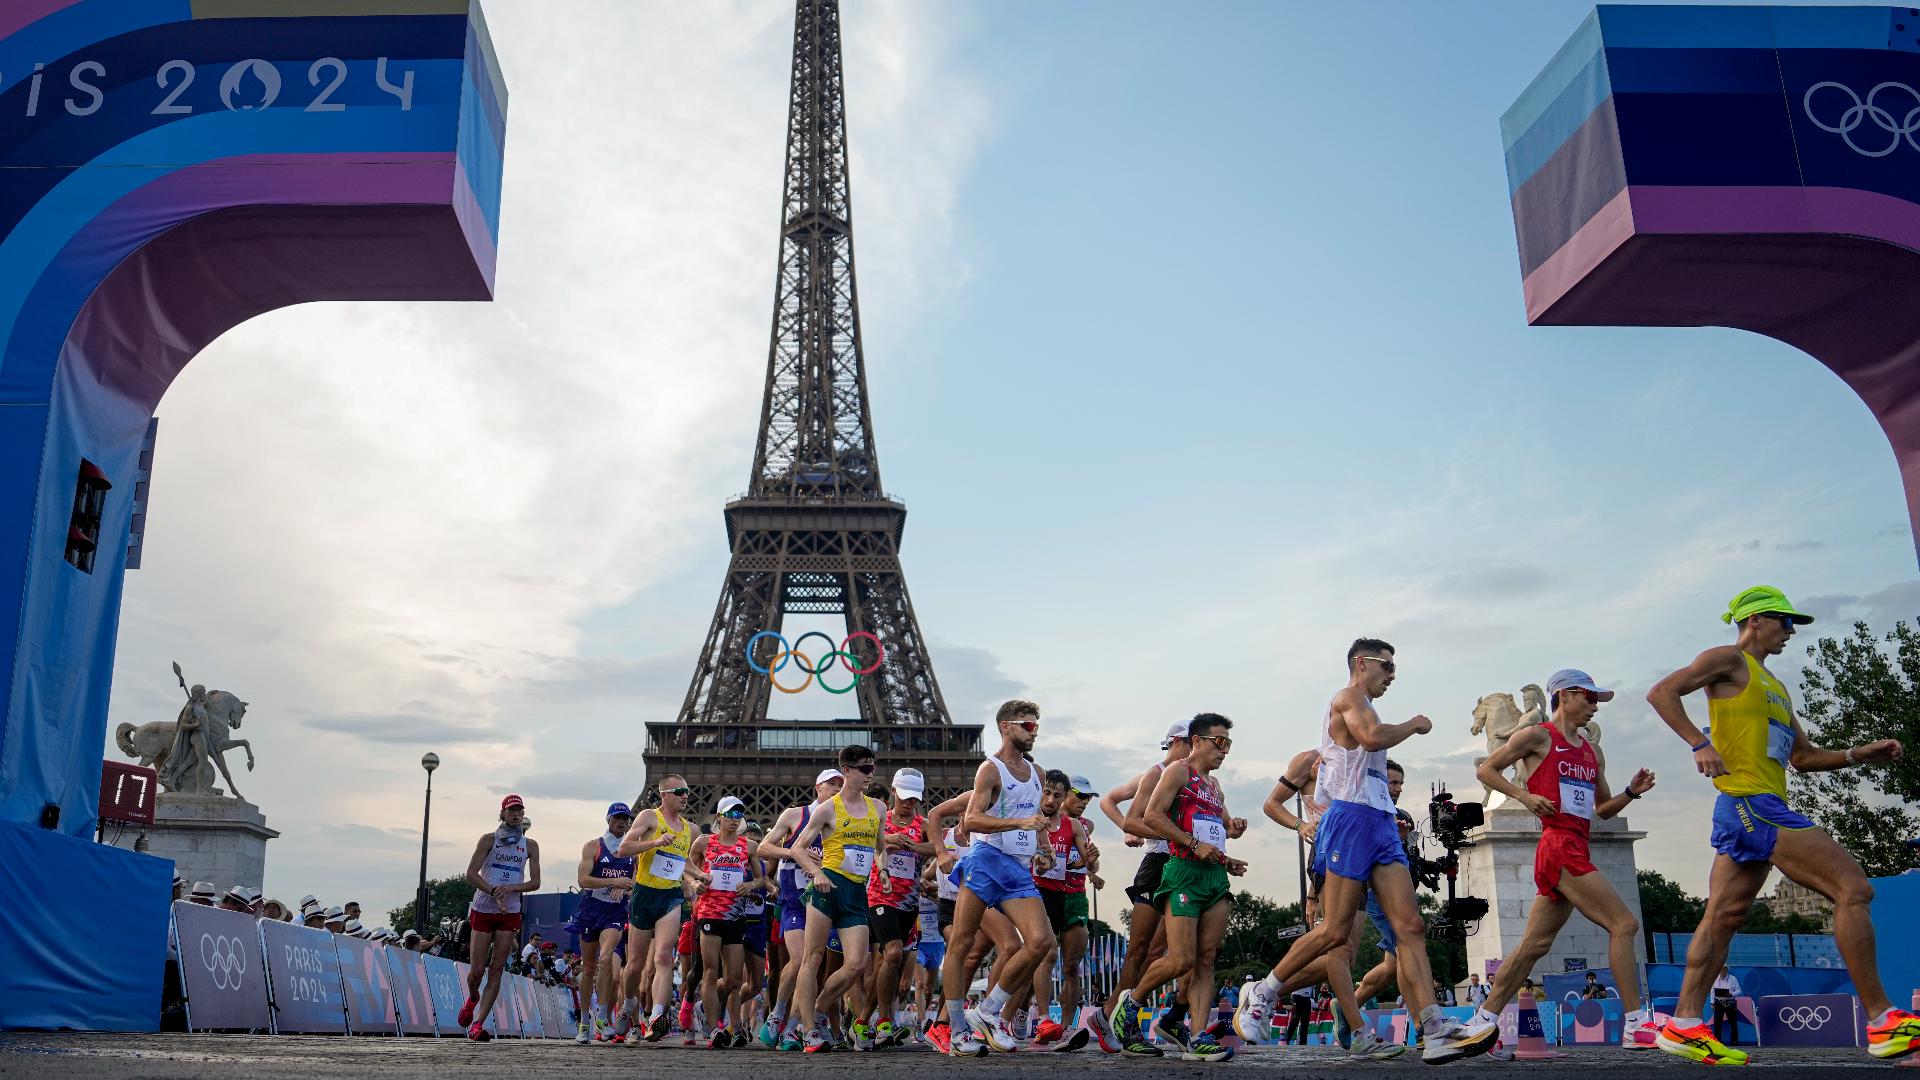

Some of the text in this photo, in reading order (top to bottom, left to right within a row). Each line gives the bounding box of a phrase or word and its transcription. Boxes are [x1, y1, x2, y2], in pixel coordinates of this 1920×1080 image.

[0, 56, 415, 117] iS 2024
[114, 774, 147, 809] 17
[1573, 790, 1584, 801] 23
[1735, 803, 1755, 833] SWEDEN
[1209, 825, 1220, 836] 65
[1018, 832, 1028, 841] 54
[496, 853, 522, 862] CANADA
[711, 856, 741, 864] JAPAN
[856, 854, 865, 862] 12
[892, 857, 904, 866] 56
[666, 860, 673, 868] 14
[502, 871, 510, 879] 18
[290, 975, 328, 1003] 2024
[1498, 1012, 1518, 1024] PA
